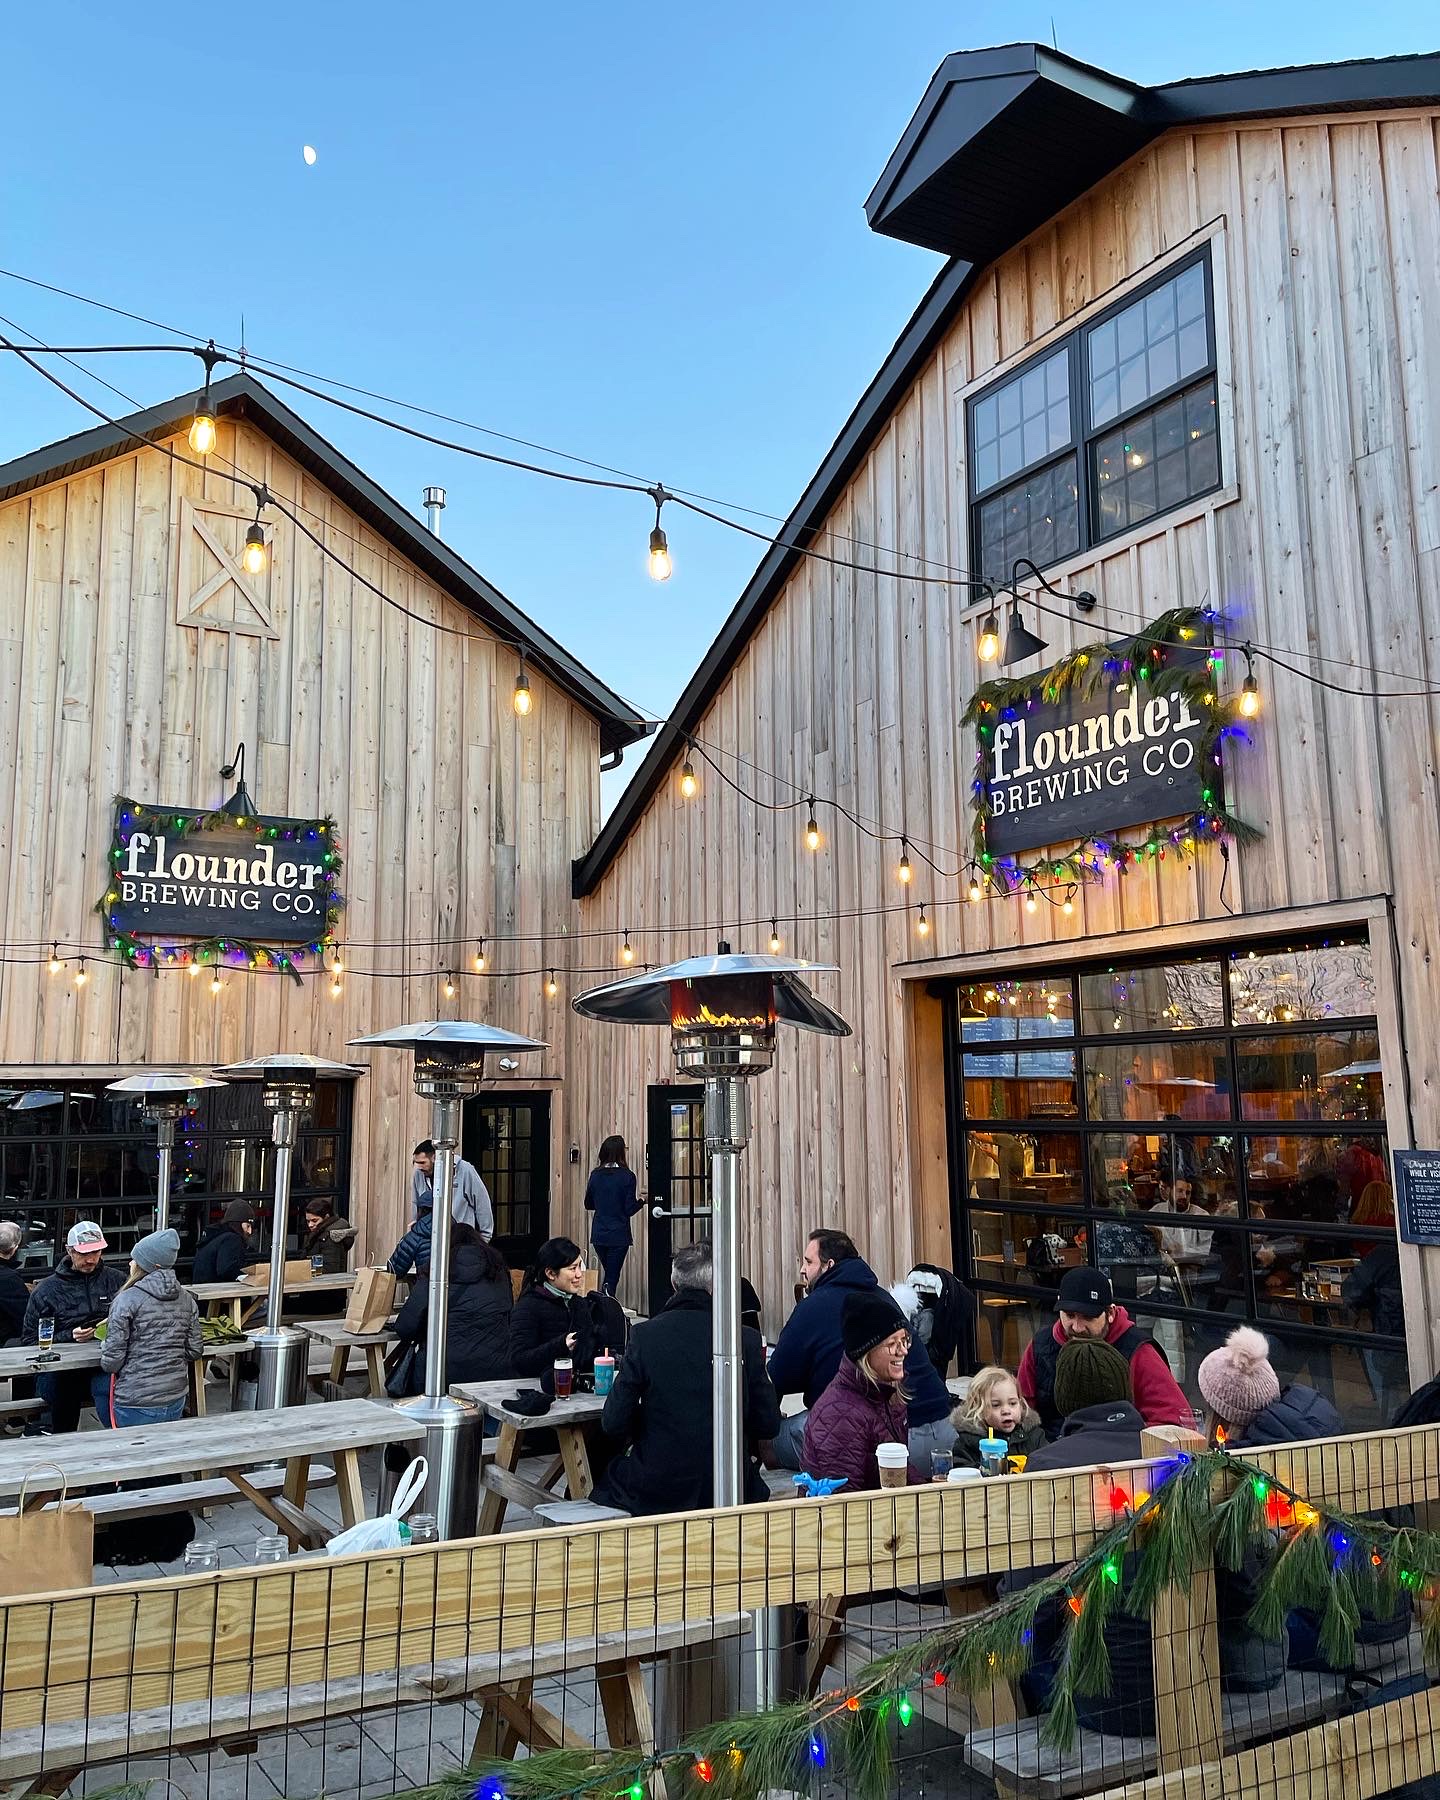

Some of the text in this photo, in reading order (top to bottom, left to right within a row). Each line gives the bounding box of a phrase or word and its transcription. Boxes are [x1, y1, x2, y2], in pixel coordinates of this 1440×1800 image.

[990, 683, 1201, 784] flounder
[991, 755, 1130, 817] BREWING
[122, 832, 322, 890] flounder
[122, 882, 261, 911] BREWING
[272, 892, 321, 914] CO.
